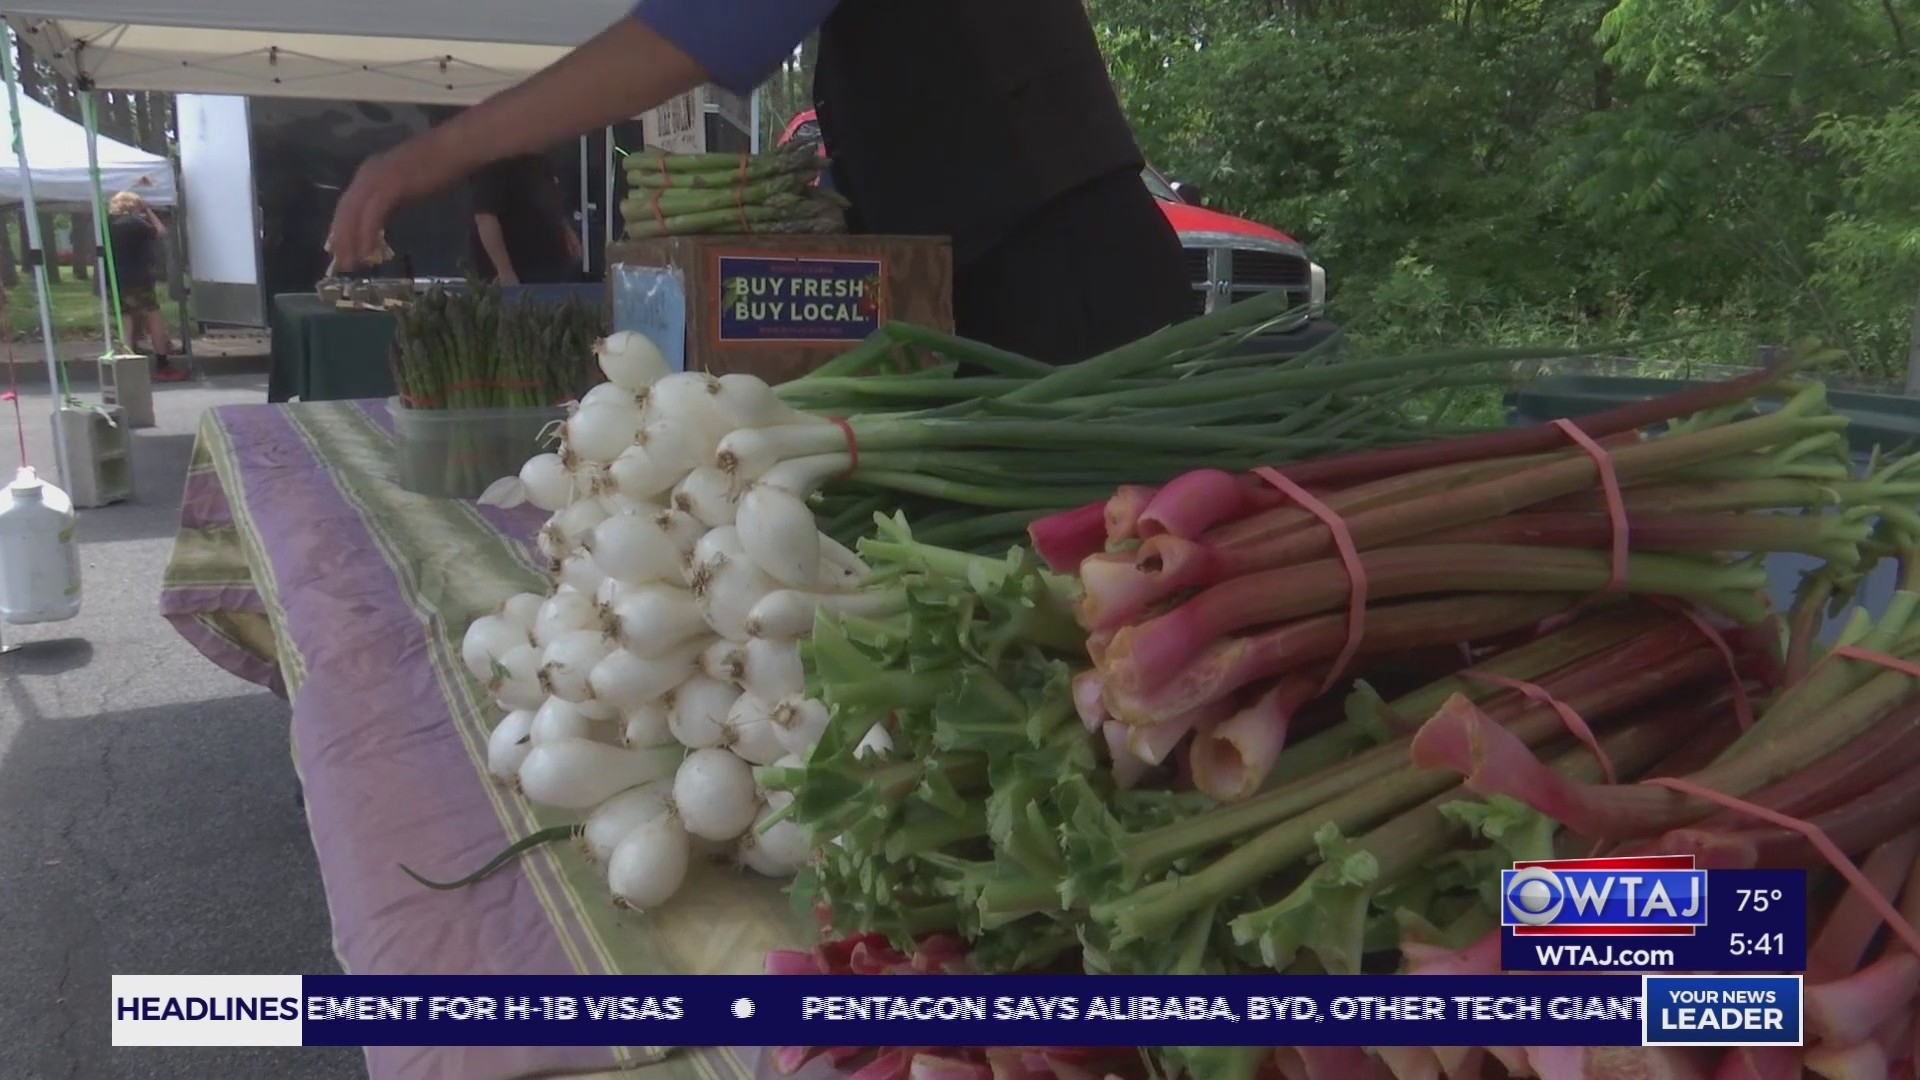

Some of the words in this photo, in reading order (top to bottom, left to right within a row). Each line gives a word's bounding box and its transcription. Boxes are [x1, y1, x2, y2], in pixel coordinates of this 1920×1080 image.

[735, 277, 784, 296] BUY
[790, 278, 864, 298] FRESH
[735, 302, 784, 321] BUY
